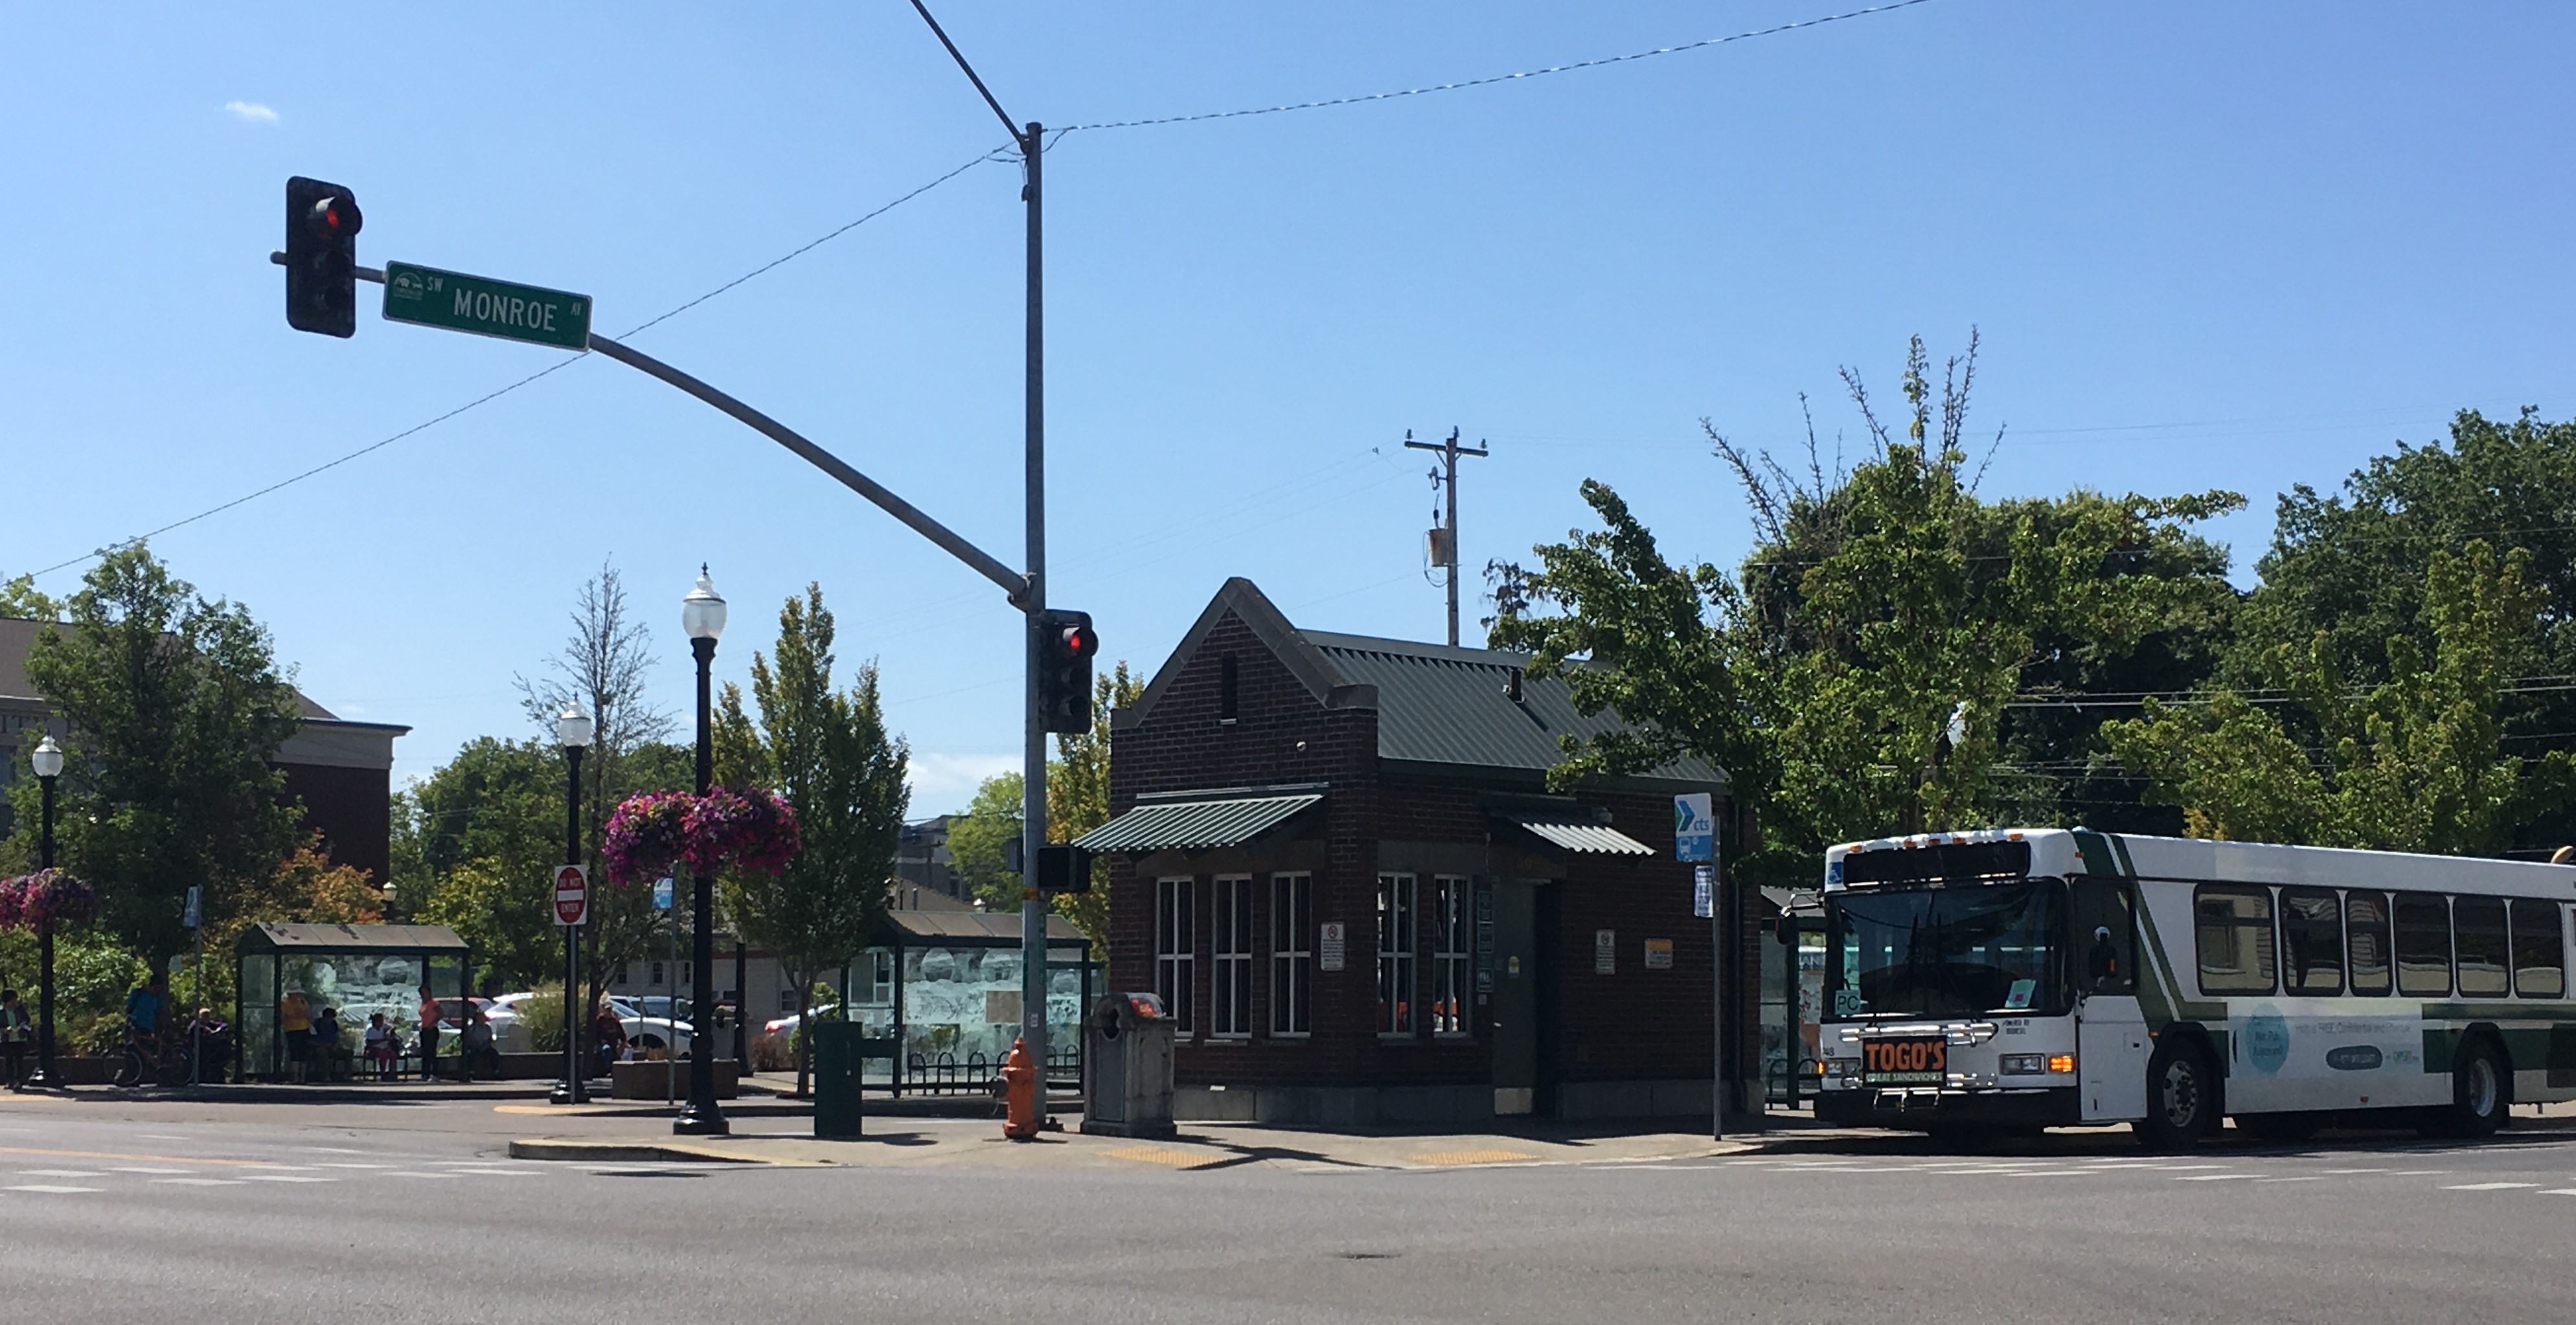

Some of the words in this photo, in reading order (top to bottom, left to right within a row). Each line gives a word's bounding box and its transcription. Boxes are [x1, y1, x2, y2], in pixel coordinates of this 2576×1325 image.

[427, 276, 443, 293] SW
[454, 288, 557, 332] MONROE
[1694, 818, 1709, 831] cts
[559, 878, 567, 888] DO
[570, 877, 582, 887] NOT
[561, 903, 580, 913] ENTER
[1837, 995, 1859, 1011] PC
[1865, 1041, 1945, 1071] TOGO'S
